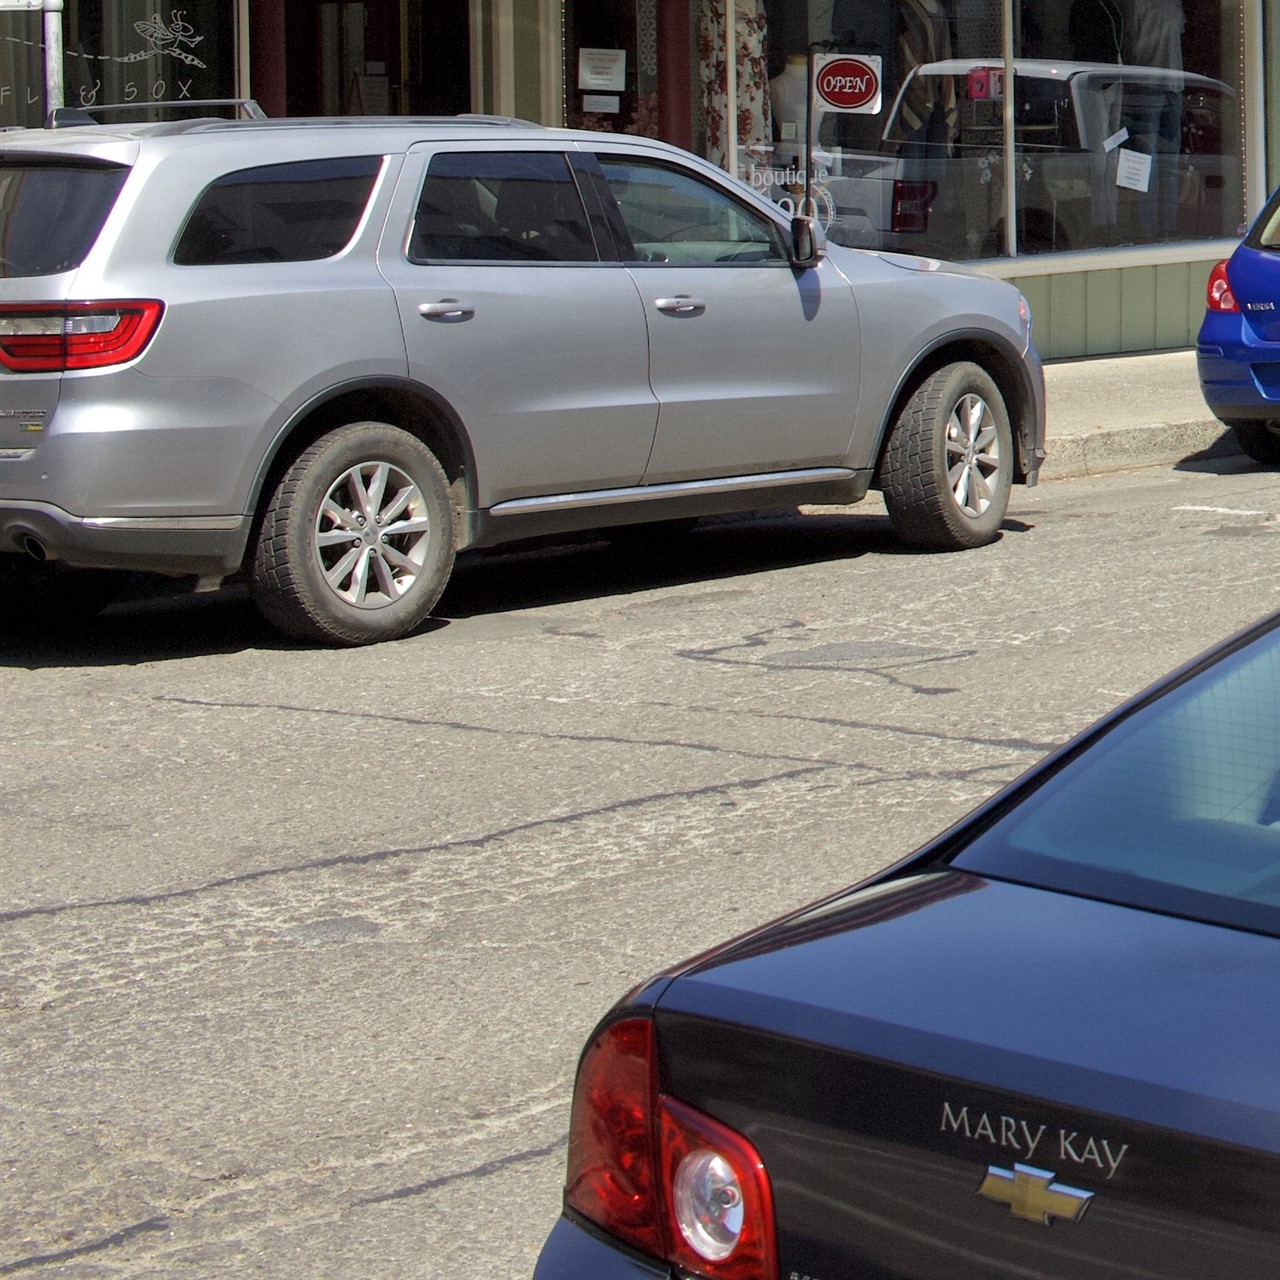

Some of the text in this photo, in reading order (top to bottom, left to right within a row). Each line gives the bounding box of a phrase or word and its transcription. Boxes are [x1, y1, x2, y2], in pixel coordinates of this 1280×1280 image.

[124, 79, 193, 101] SOX
[823, 75, 870, 94] OPEN
[940, 1101, 1128, 1180] MARY KAY
